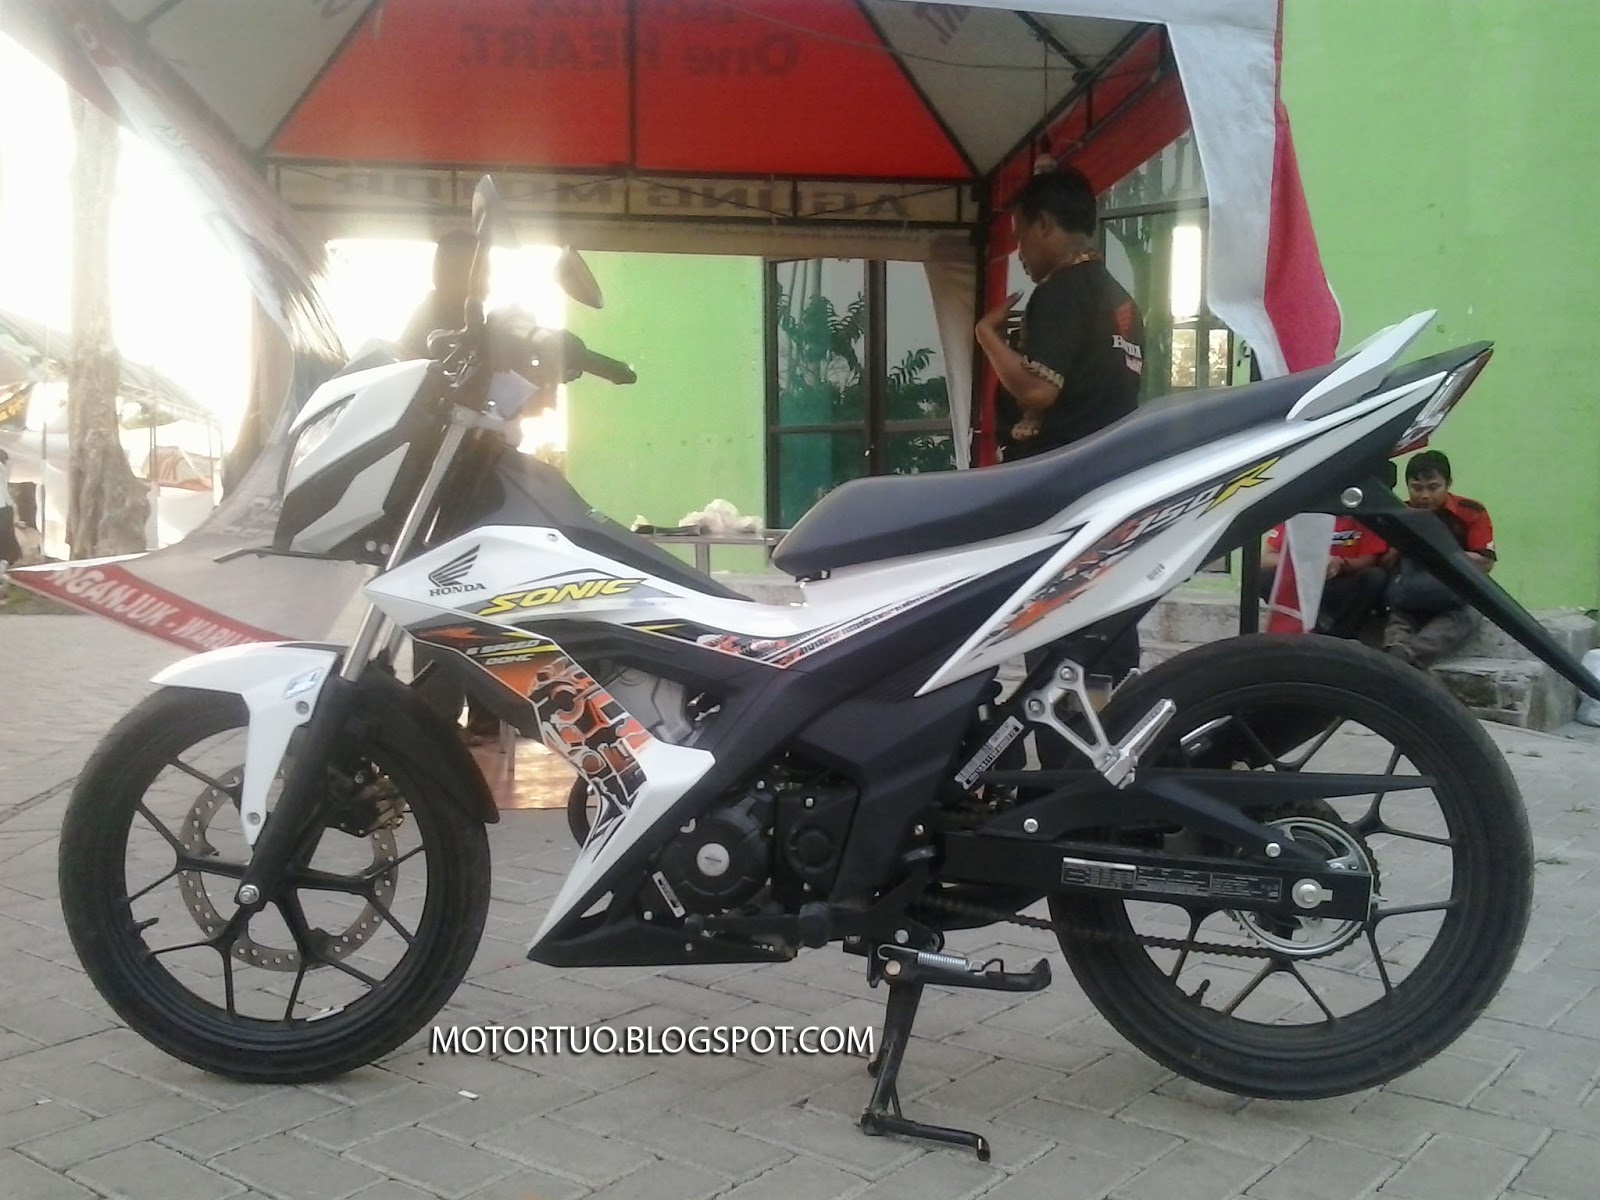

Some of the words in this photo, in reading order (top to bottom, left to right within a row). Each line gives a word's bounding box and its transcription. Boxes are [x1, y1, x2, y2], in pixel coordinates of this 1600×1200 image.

[428, 582, 487, 597] HONDA
[476, 577, 648, 617] SONIC
[480, 639, 541, 653] SPEED
[485, 654, 536, 666] DOHC
